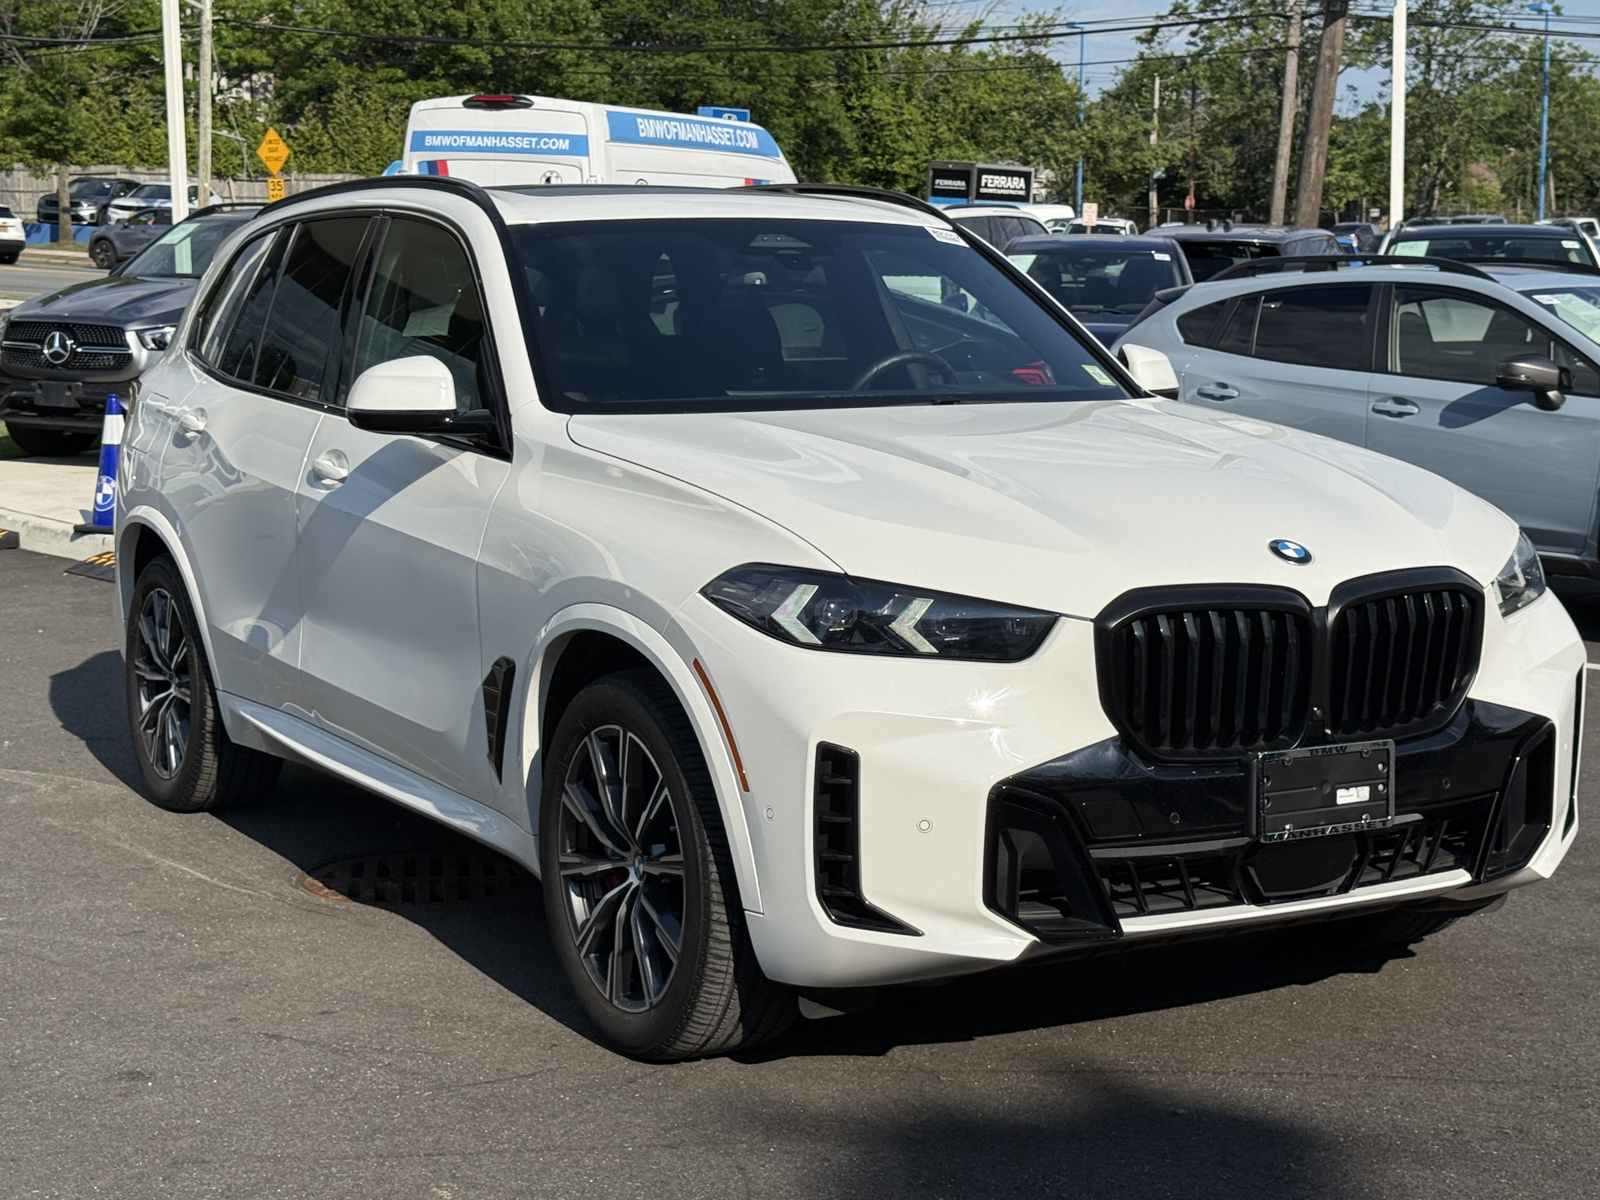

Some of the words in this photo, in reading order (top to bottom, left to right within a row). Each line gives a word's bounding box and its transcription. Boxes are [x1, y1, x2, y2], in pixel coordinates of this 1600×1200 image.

[637, 117, 759, 149] BMWOFMANHASSET.COM
[424, 135, 570, 150] BMWOFMANHASSET.COM
[270, 180, 283, 192] 35
[935, 179, 966, 187] FERRARA
[981, 174, 1026, 189] FERRARA
[1309, 745, 1348, 756] BMW
[1268, 821, 1389, 841] MANHASSET
